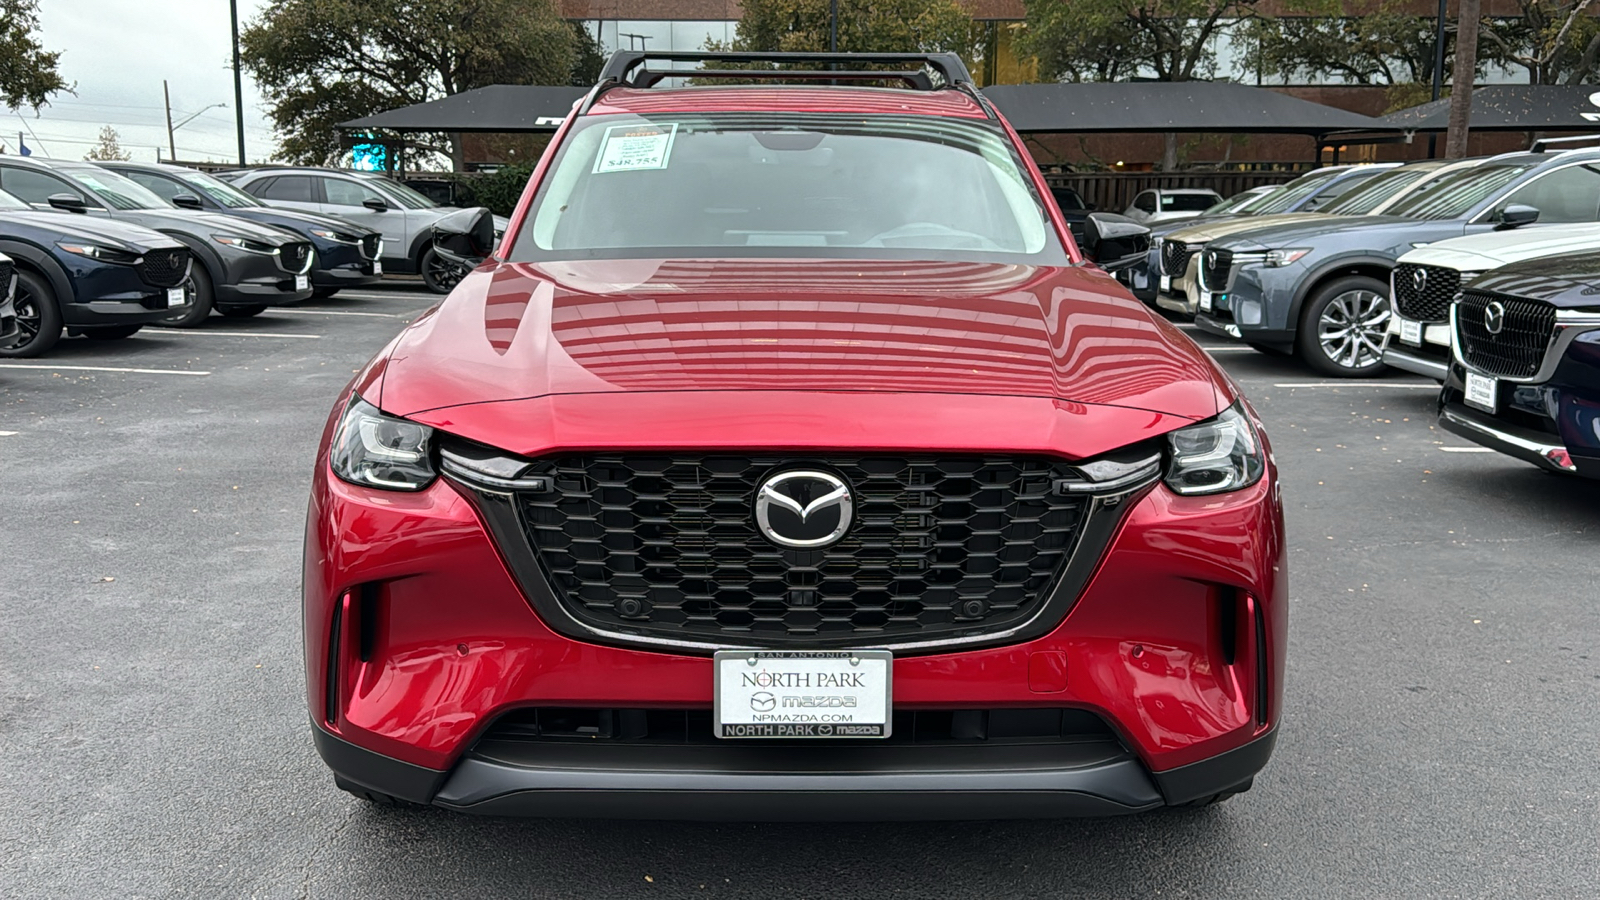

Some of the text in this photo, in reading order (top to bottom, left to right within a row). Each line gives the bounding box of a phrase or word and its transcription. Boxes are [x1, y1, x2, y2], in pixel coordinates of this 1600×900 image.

[741, 672, 866, 688] NORTH PARK
[782, 695, 857, 708] mazda
[752, 714, 853, 722] NPMAZDA.COM
[725, 724, 880, 736] NORTH PARK mazda
